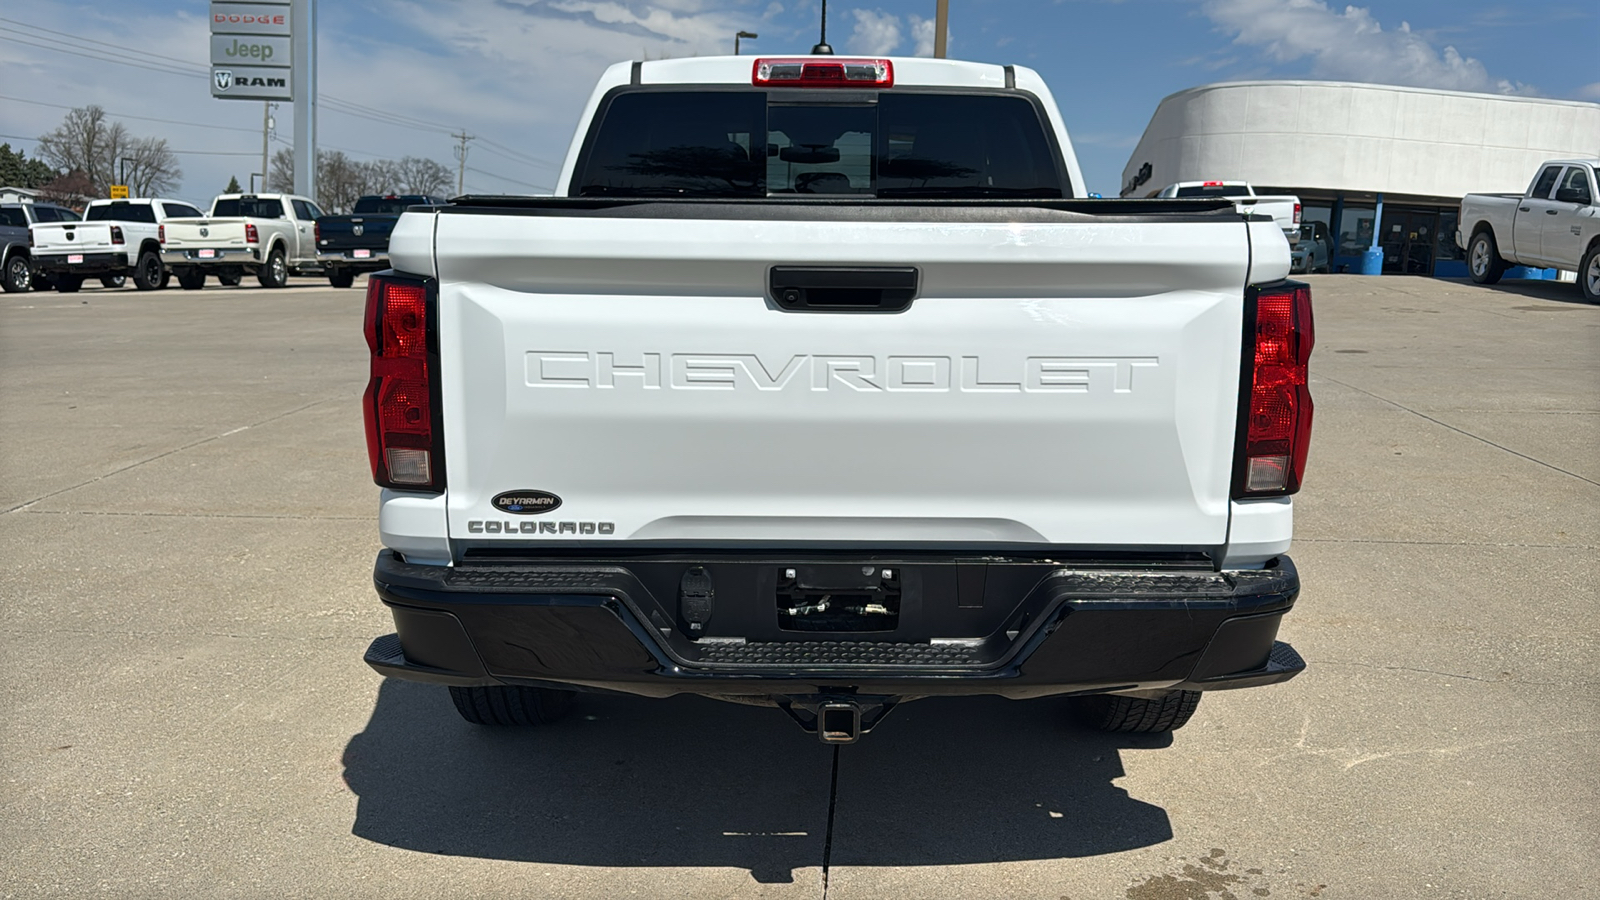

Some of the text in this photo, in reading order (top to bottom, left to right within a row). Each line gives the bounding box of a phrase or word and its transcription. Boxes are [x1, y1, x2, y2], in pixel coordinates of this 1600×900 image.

[214, 14, 285, 25] DODGE
[225, 39, 273, 61] Jeep
[235, 77, 286, 87] RAM
[524, 351, 1160, 393] CHEVROLET
[498, 497, 554, 505] DEYARMAN
[467, 520, 616, 535] COLORADO
